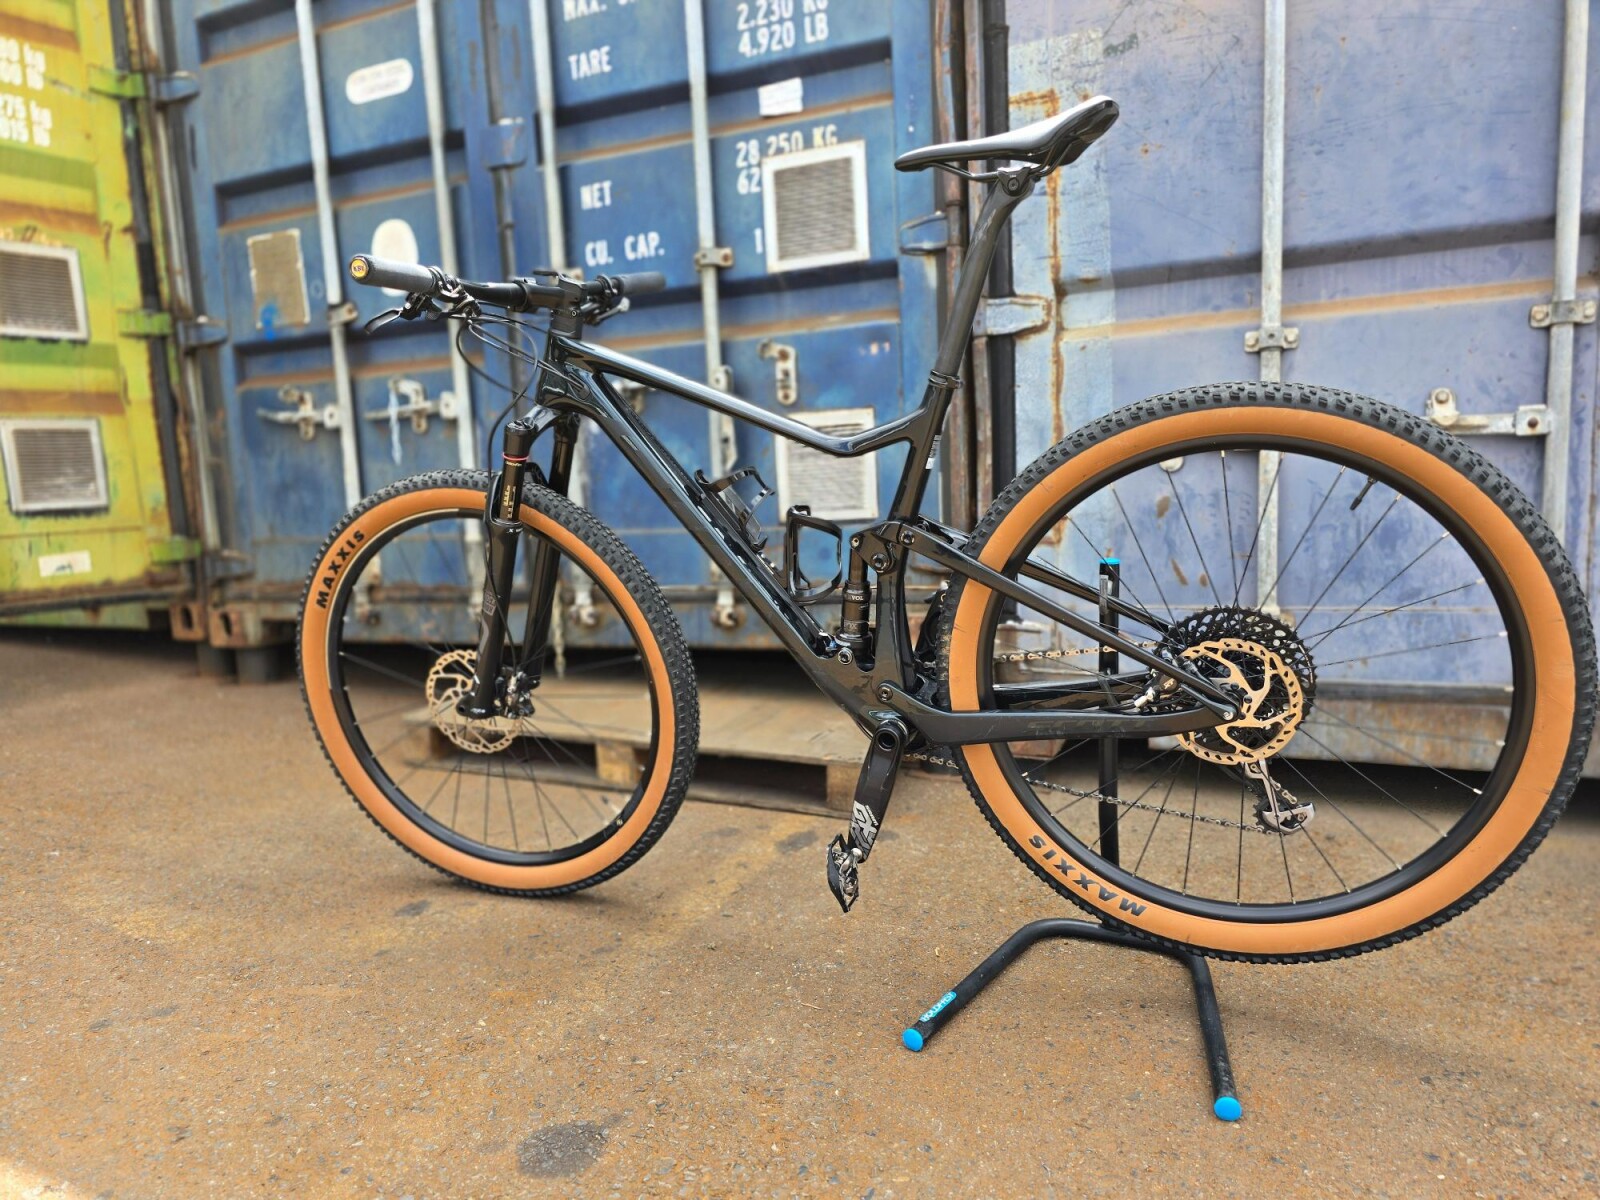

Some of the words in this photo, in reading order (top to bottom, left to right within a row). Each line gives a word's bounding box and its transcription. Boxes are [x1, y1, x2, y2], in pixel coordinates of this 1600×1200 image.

[737, 0, 794, 31] 2.230
[738, 20, 795, 57] 4.920
[804, 13, 829, 44] LB
[568, 46, 612, 80] TARE
[812, 124, 838, 149] KG
[580, 181, 612, 210] NET
[585, 240, 613, 267] CU.
[624, 232, 665, 261] CAP.
[316, 530, 364, 609] MAXXIS
[1028, 834, 1147, 917] MAXXIS
